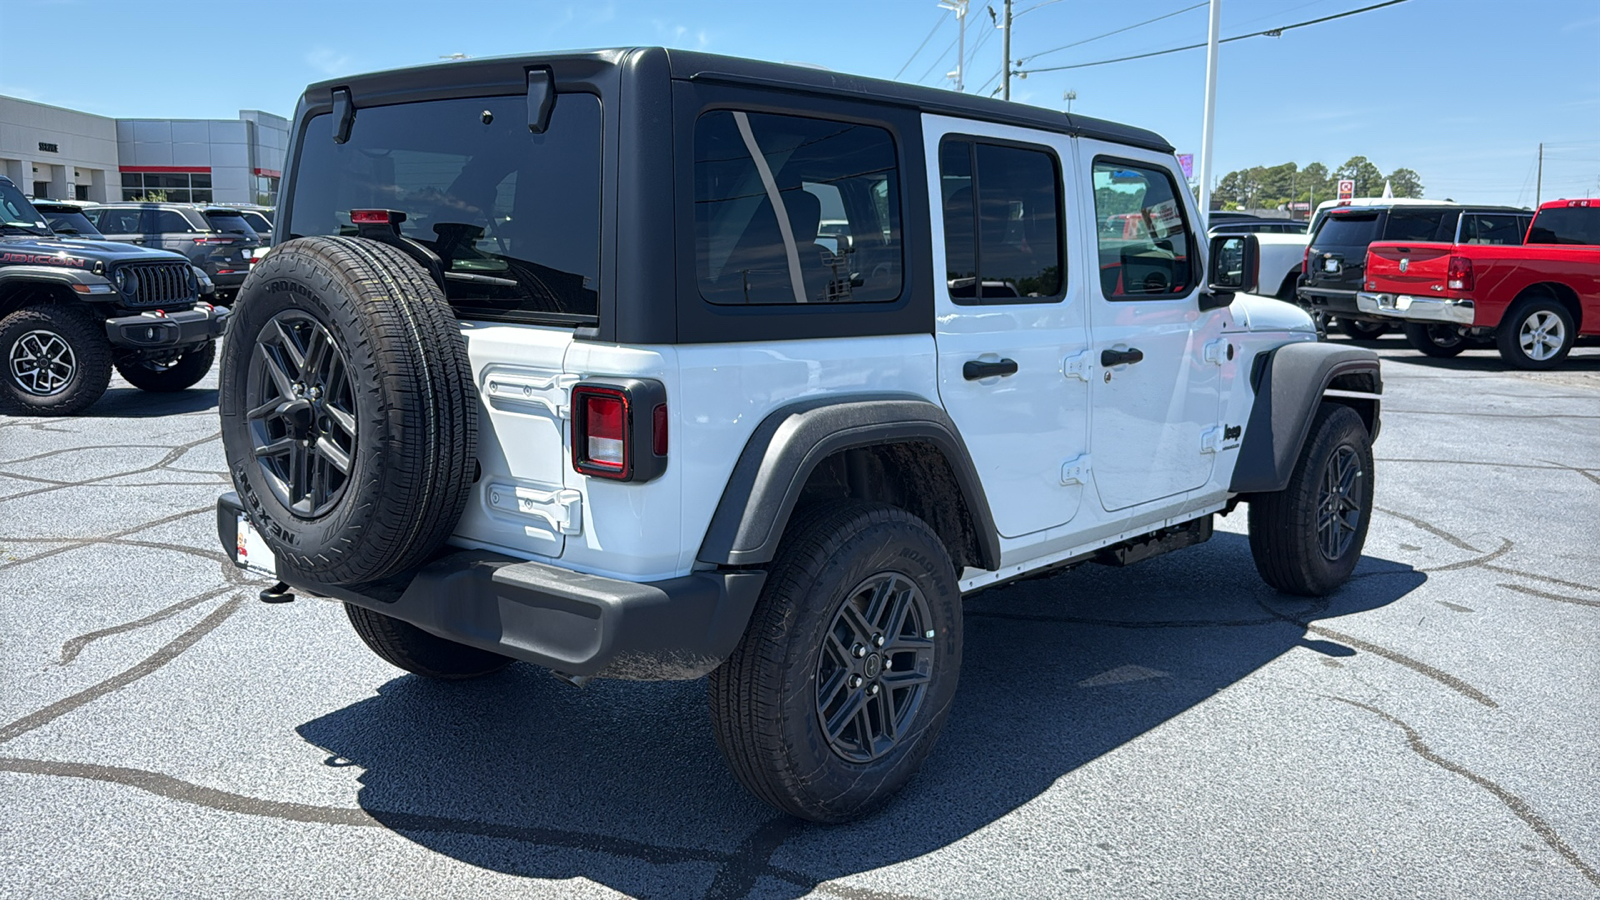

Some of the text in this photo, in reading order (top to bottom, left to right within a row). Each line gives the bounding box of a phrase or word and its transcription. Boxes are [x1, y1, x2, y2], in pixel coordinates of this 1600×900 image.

[0, 253, 85, 267] UBICON
[270, 280, 331, 317] ROADIAN
[1223, 423, 1242, 441] Jeep
[239, 470, 295, 546] NEXEN
